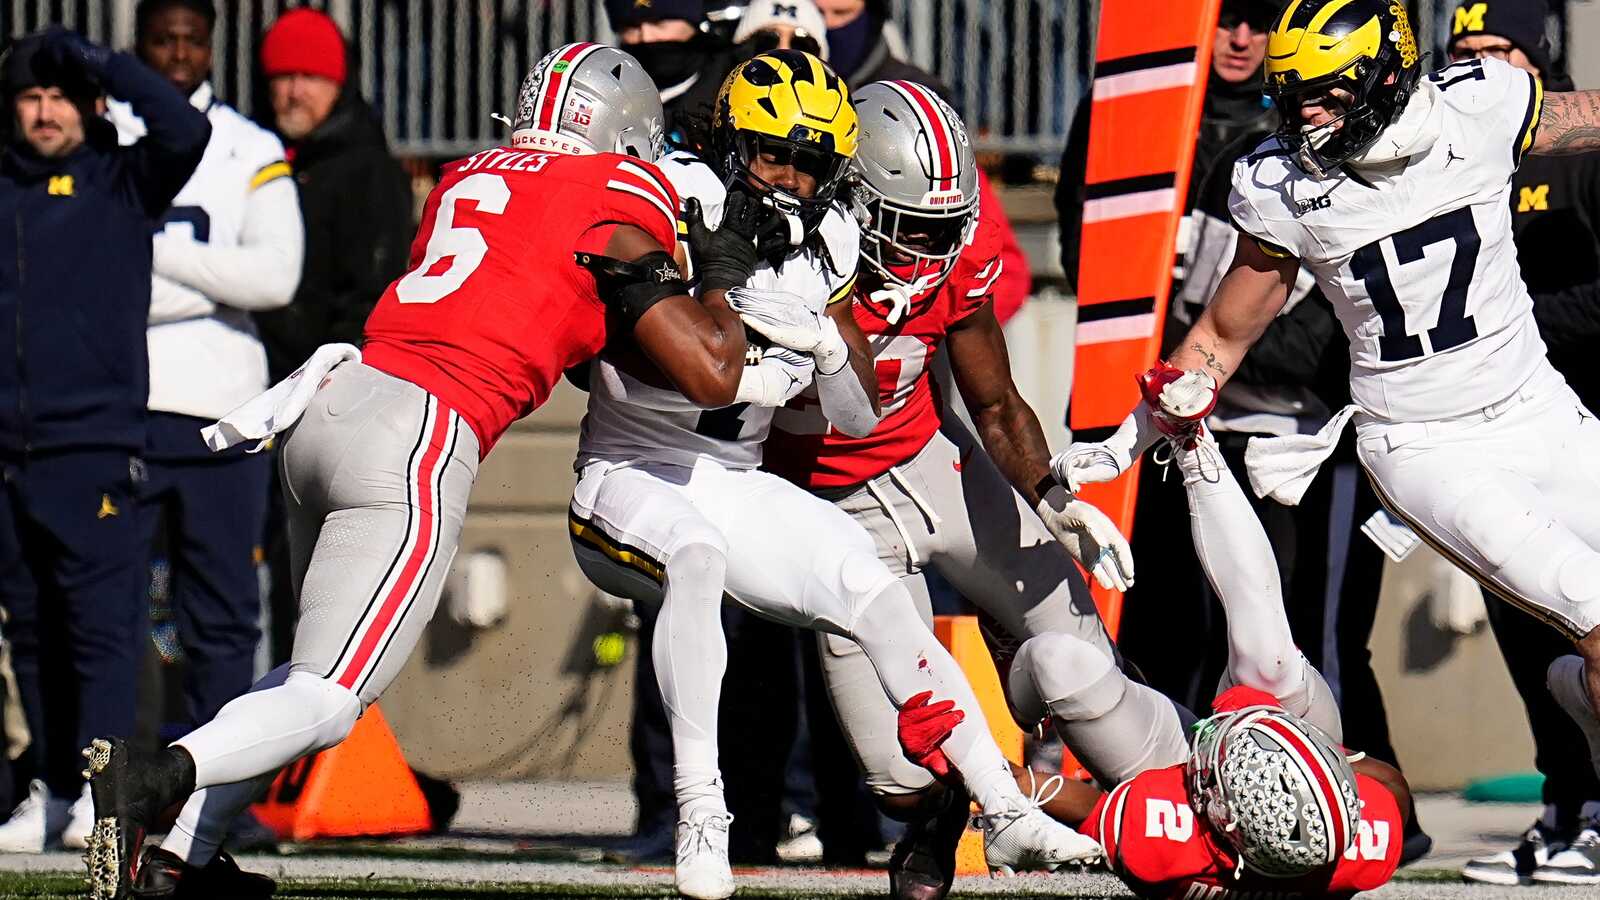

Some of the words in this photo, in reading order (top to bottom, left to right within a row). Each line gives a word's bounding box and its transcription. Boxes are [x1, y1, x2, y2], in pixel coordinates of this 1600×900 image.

[773, 4, 797, 17] M
[1453, 3, 1487, 35] M
[1274, 73, 1288, 85] M
[569, 98, 575, 107] 6
[807, 129, 822, 143] M
[457, 149, 559, 173] STYLES
[48, 175, 74, 195] M
[930, 197, 945, 205] OHIO
[946, 195, 962, 204] STATE
[1517, 184, 1550, 212] M
[395, 172, 512, 303] 6
[1349, 204, 1482, 361] 17
[1145, 798, 1193, 842] 2
